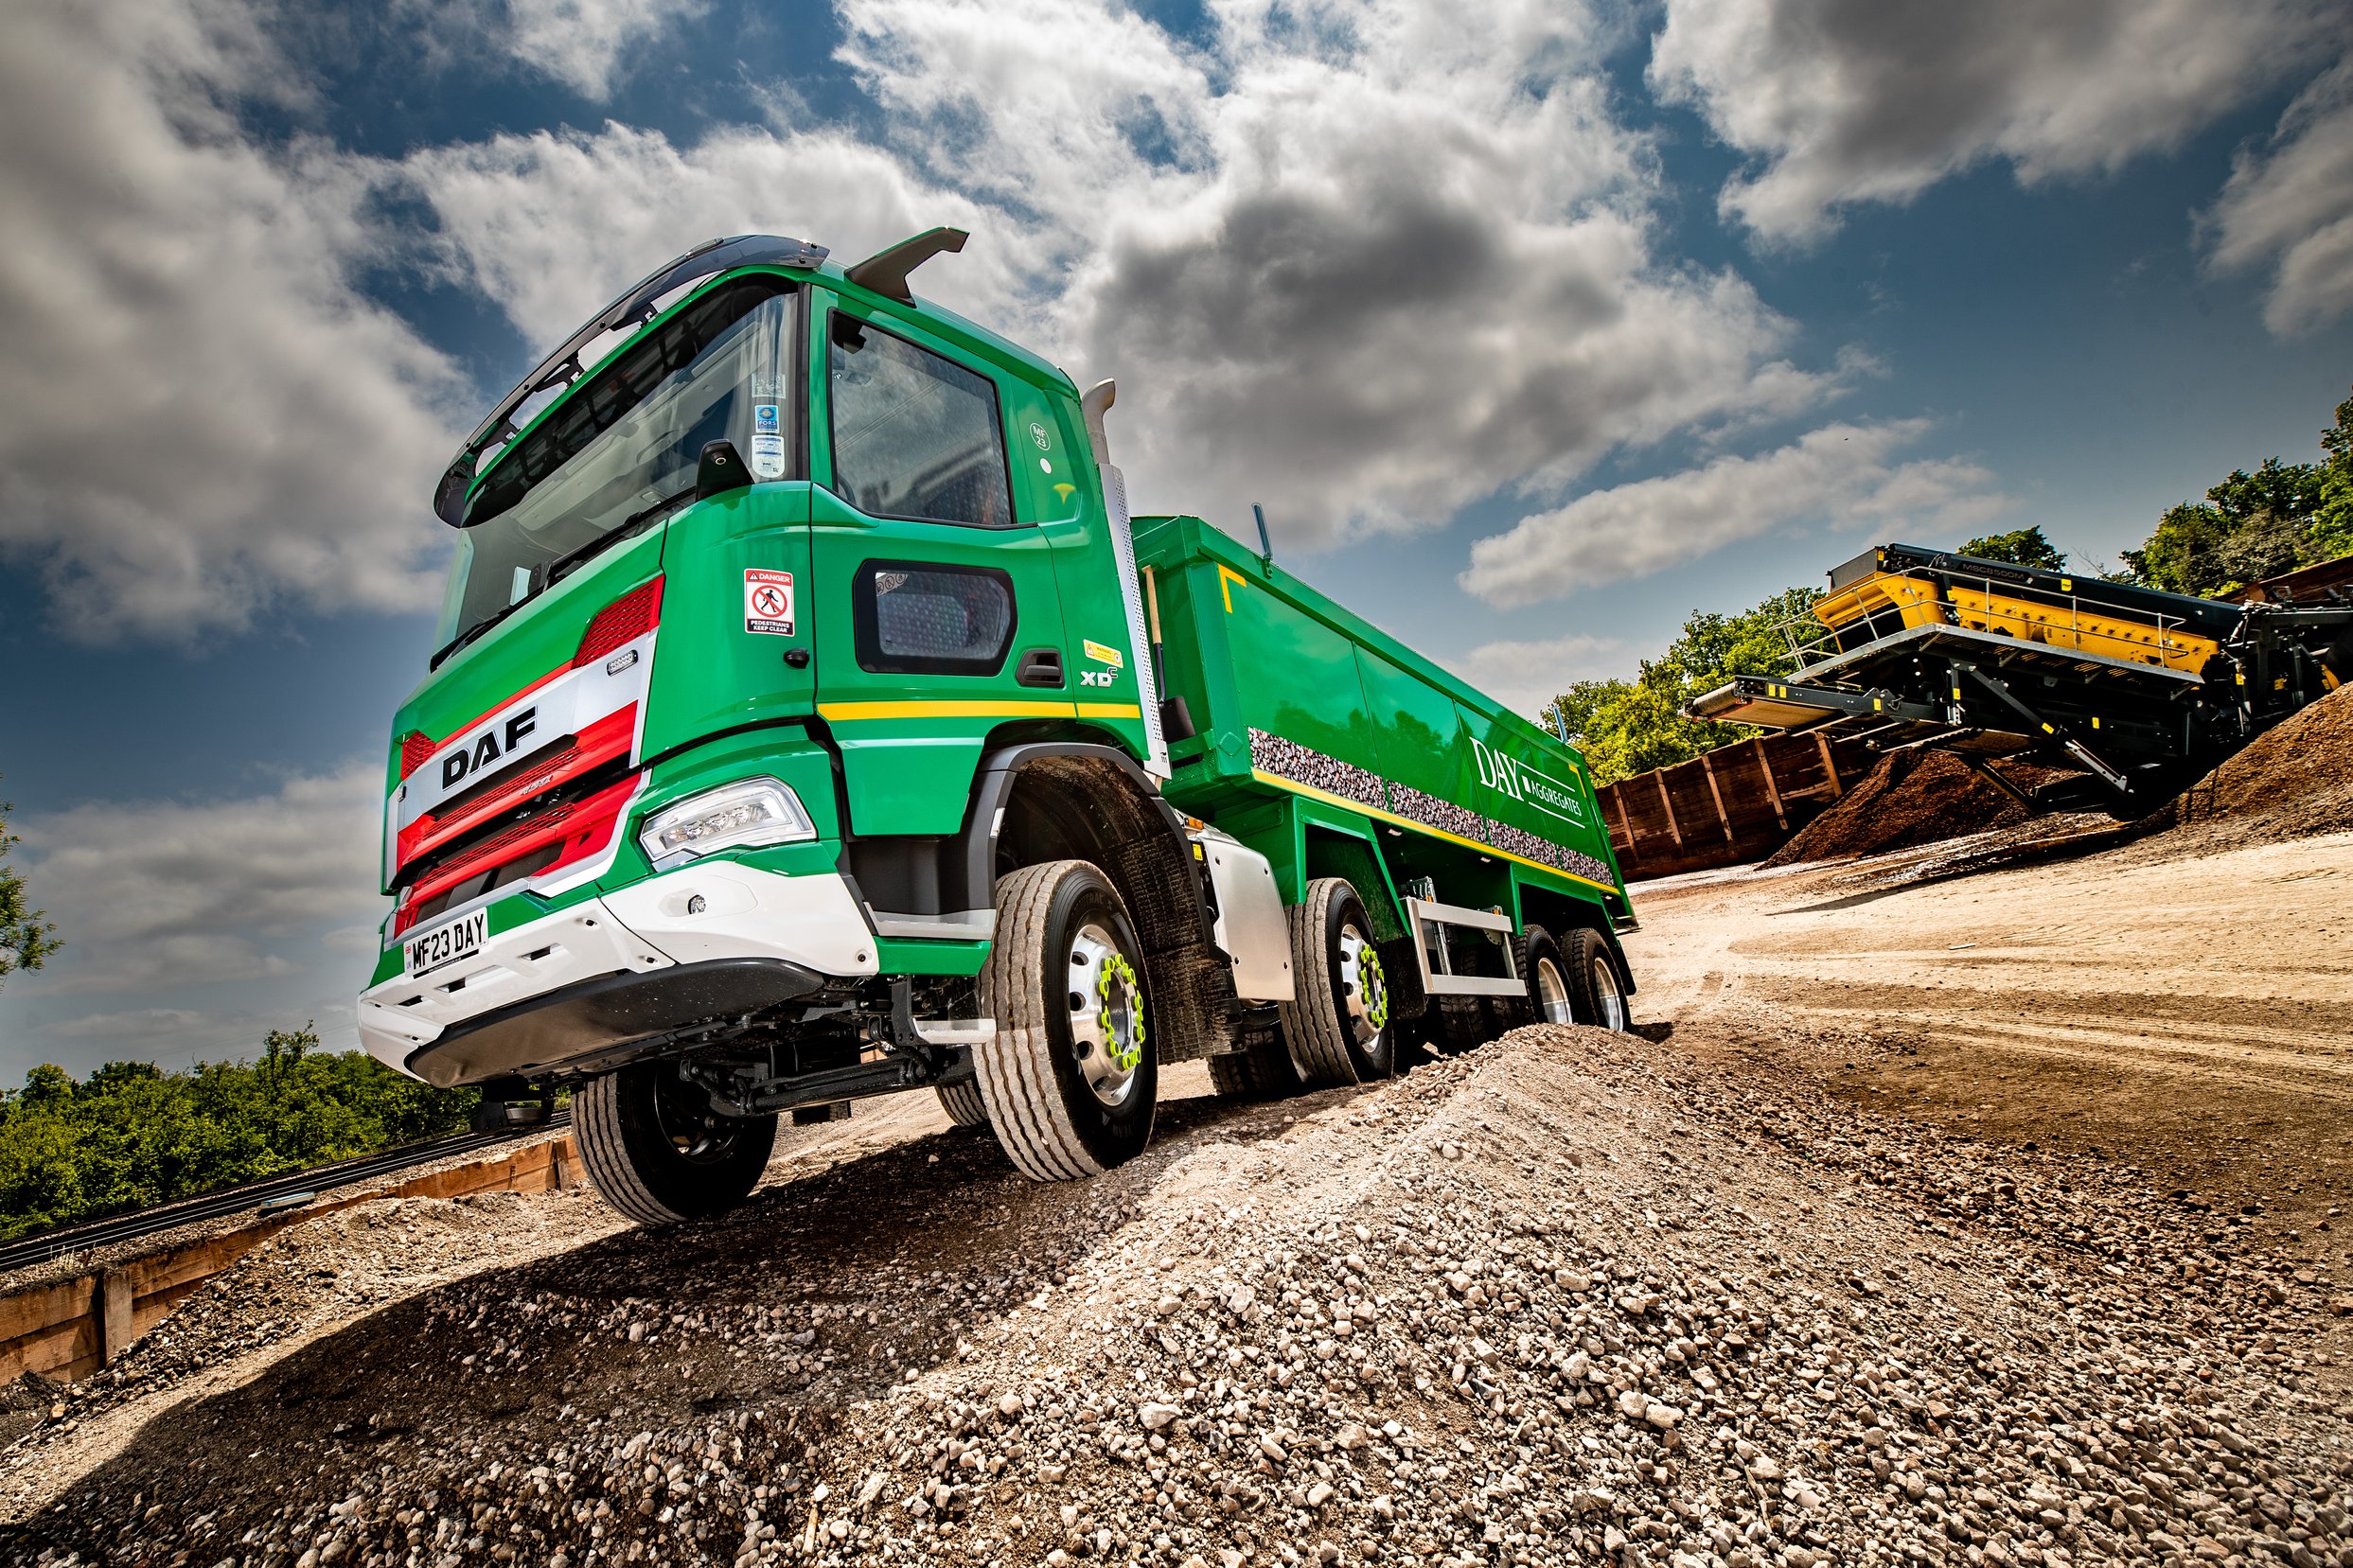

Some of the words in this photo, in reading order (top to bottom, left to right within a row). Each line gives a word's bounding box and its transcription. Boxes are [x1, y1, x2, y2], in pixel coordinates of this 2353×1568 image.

[1033, 425, 1045, 437] MF
[1036, 435, 1047, 448] 23
[758, 573, 790, 583] DANGER
[751, 620, 790, 628] PEDESTRIANS
[441, 705, 538, 791] DAF
[1469, 736, 1524, 802] DAY
[1530, 780, 1582, 817] AGGREGATES
[412, 928, 450, 970] MF23
[453, 913, 484, 953] DAY
